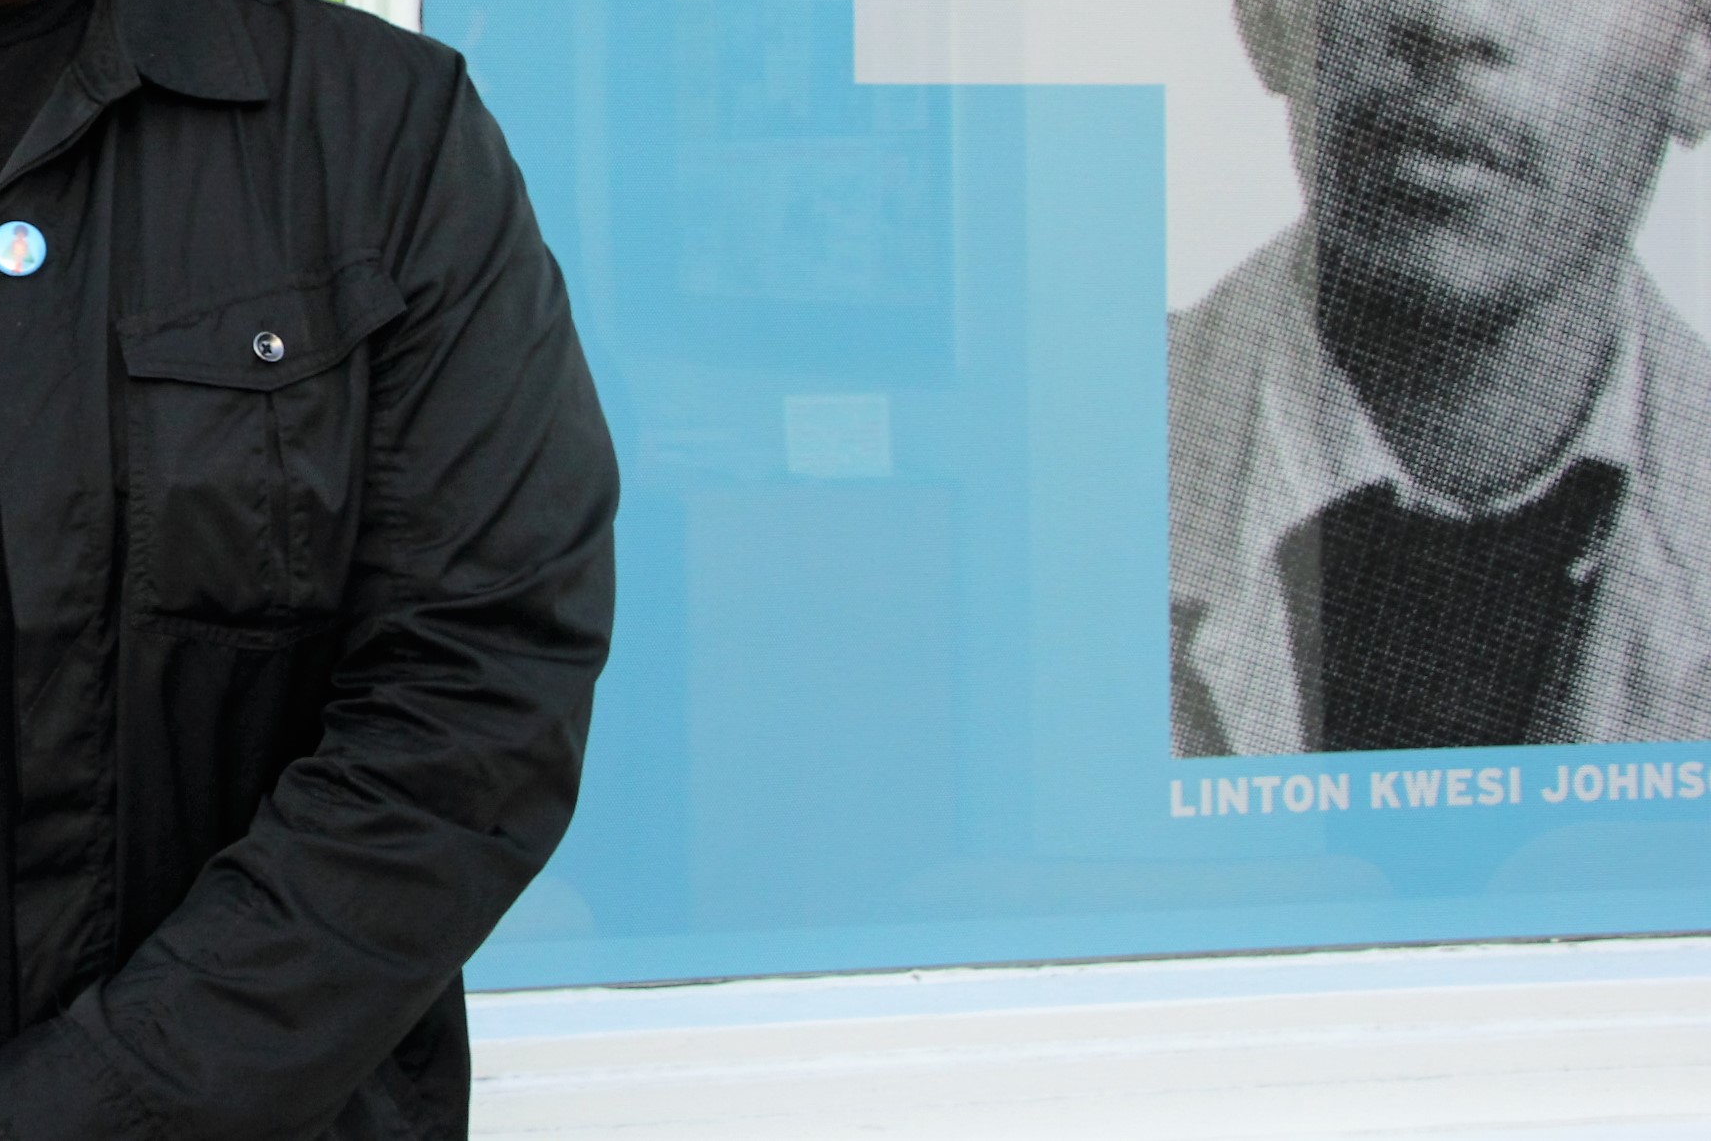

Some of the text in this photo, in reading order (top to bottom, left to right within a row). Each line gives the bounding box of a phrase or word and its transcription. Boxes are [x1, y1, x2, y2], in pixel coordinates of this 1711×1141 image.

[1170, 761, 1711, 817] LINTON KWESI JOHNS
